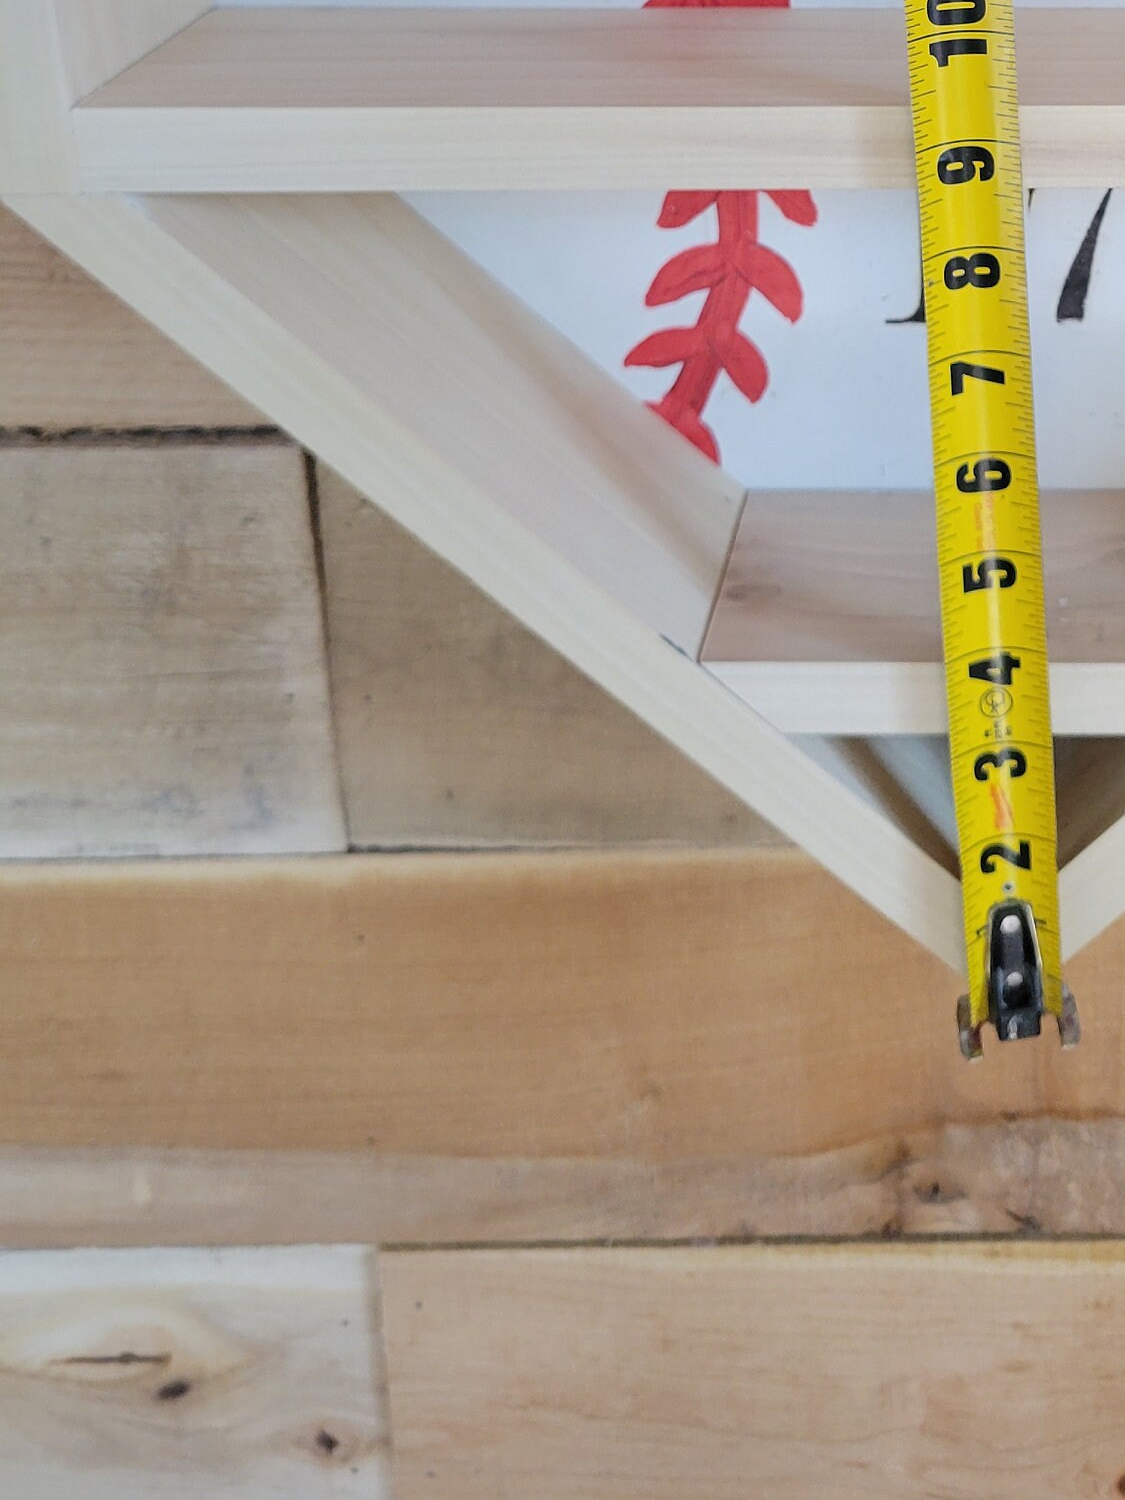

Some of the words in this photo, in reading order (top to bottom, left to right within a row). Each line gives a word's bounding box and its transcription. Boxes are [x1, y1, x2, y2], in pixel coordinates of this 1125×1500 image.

[937, 146, 995, 185] 9
[943, 252, 1000, 290] 8
[949, 362, 1006, 396] 7
[956, 457, 1012, 493] 6
[962, 557, 1017, 594] 5
[968, 651, 1021, 686] 4
[974, 746, 1027, 781] 3
[980, 839, 1032, 874] 2
